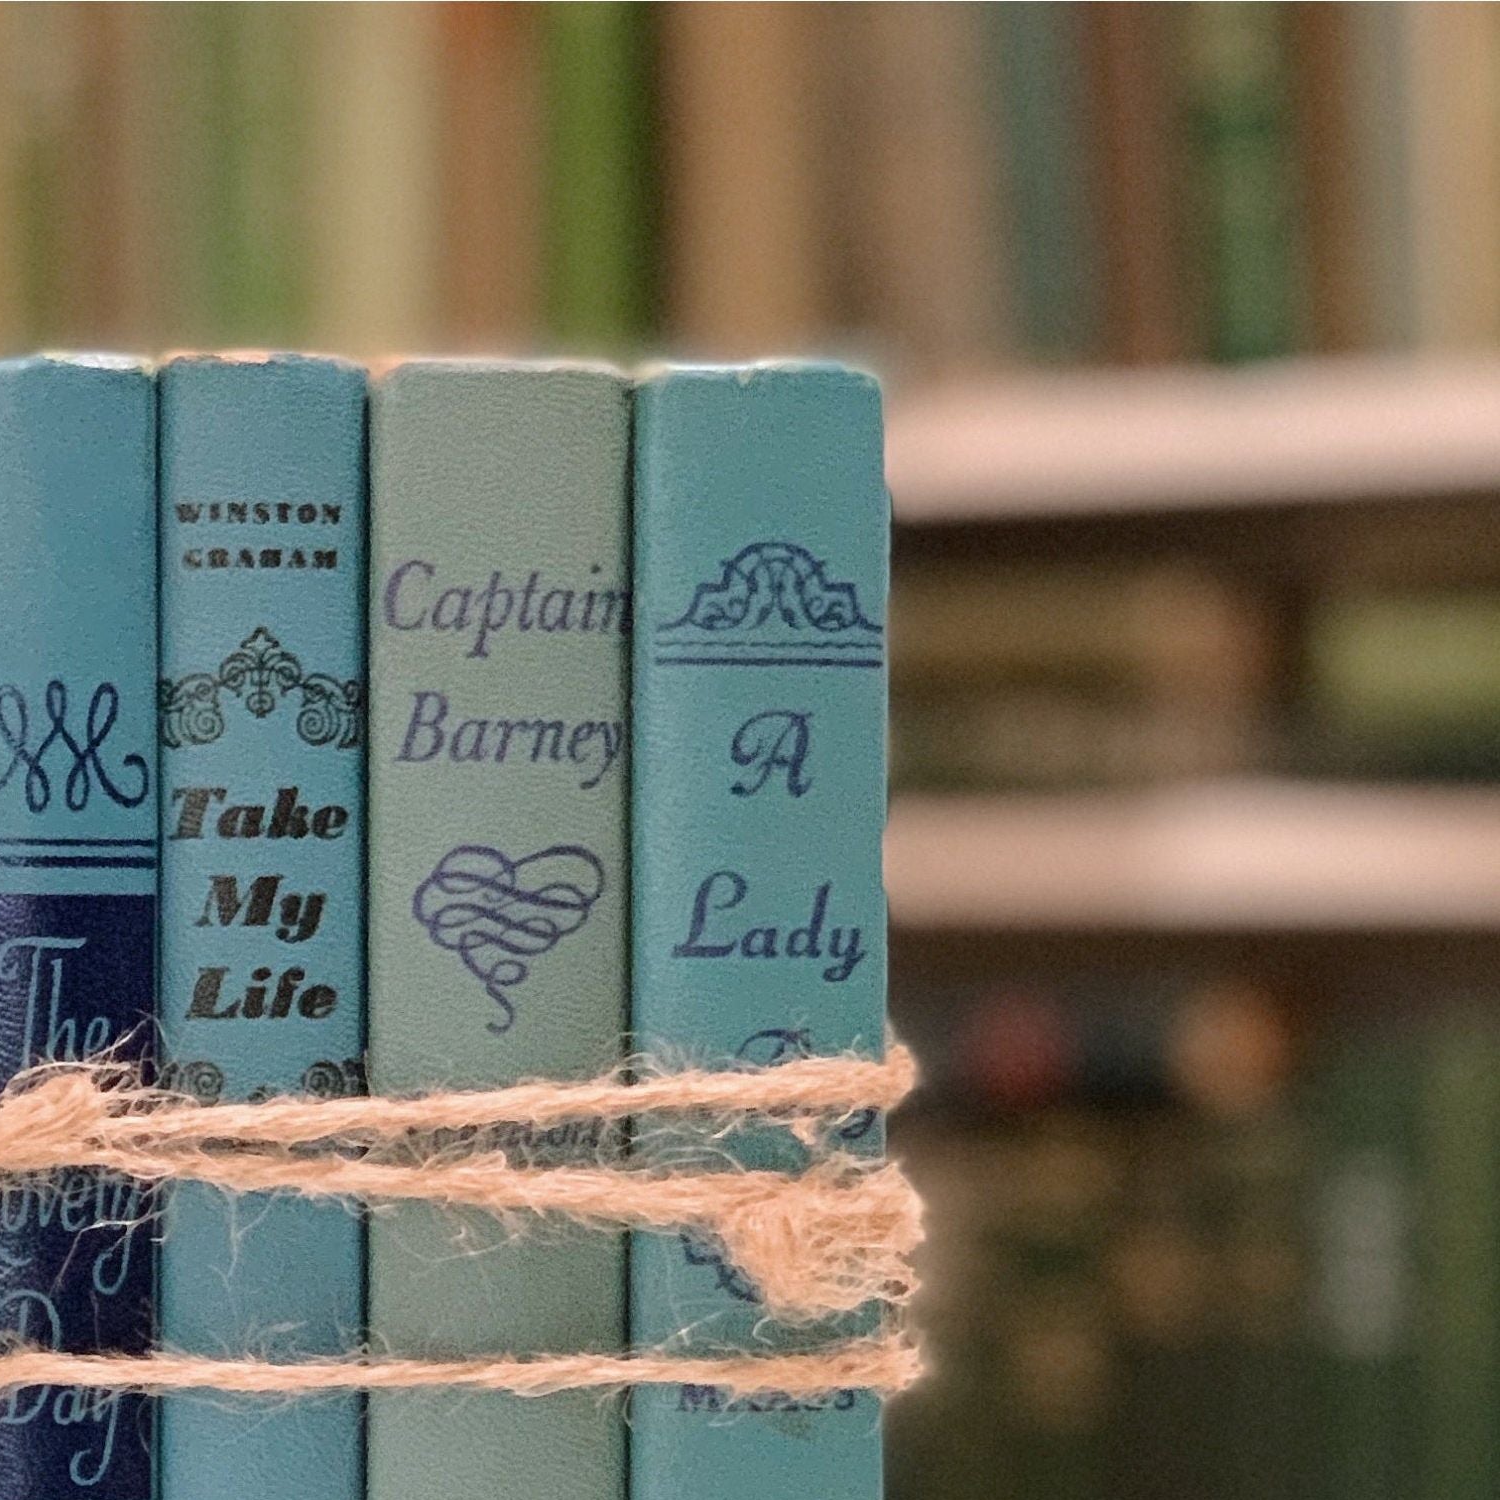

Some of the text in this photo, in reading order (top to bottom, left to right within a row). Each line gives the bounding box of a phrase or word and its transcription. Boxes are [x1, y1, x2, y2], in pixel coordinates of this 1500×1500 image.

[175, 502, 342, 524] WINSTON
[182, 548, 338, 569] GRAHAM
[384, 560, 633, 660] Captain
[394, 691, 625, 790] Barney
[730, 710, 813, 799] A
[168, 786, 350, 841] Take
[194, 874, 328, 944] My
[672, 871, 866, 983] Lady
[185, 966, 339, 1021] Life
